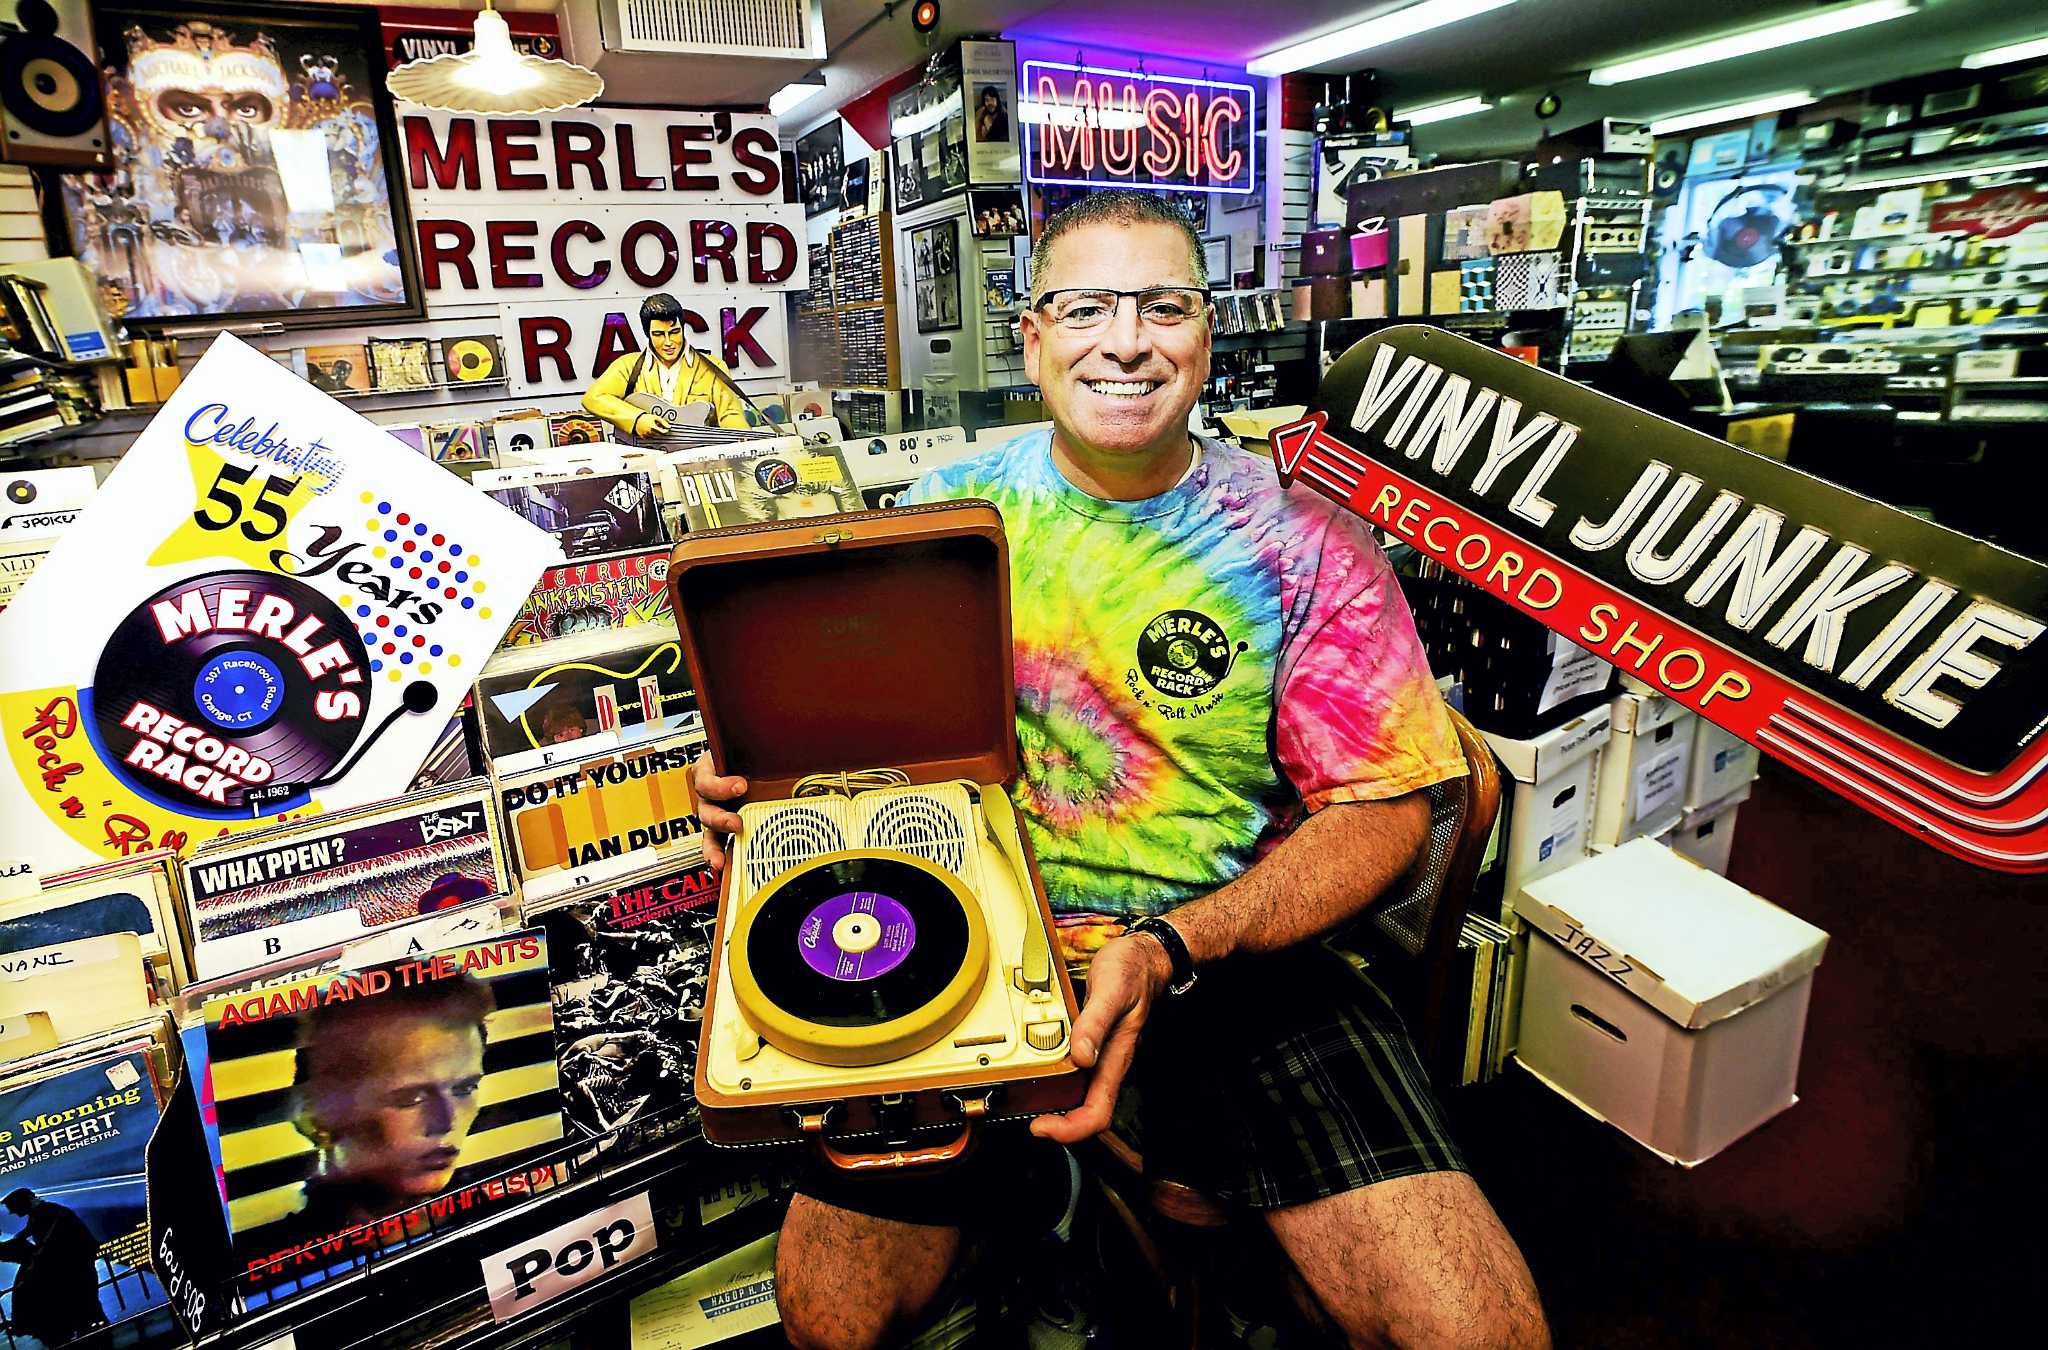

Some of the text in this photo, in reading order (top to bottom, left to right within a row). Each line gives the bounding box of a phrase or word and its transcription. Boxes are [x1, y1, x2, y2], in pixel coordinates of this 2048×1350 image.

[402, 112, 781, 196] MERLE'S
[1038, 75, 1243, 181] MUSIC
[417, 218, 799, 290] RECORD
[184, 403, 347, 496] Celebrating
[193, 463, 303, 542] 55
[681, 470, 738, 507] BILLY
[1350, 341, 2048, 730] VINYL JUNKIE
[269, 524, 443, 625] Years
[1370, 485, 1752, 708] RECORD SHOP
[150, 587, 365, 722] MERLE'S
[1146, 617, 1228, 659] MERLE'S
[204, 660, 277, 712] 307 Racebrook Road
[1151, 665, 1206, 687] RECORD
[1156, 677, 1195, 695] RACK
[202, 693, 253, 724] Orange, CT
[1157, 704, 1187, 721] Roll
[22, 696, 85, 793] Rock
[120, 700, 276, 785] RECORD
[124, 738, 241, 806] RACK
[266, 785, 290, 798] 1962
[500, 740, 711, 812] DO IT YOURSE
[567, 814, 704, 869] IAN DURY
[607, 884, 660, 919] THE
[1, 952, 75, 974] VANI
[263, 936, 282, 957] B
[405, 935, 425, 955] A
[1553, 923, 1633, 985] JAZZ
[217, 936, 541, 1031] ADAM AND THE ANTS
[20, 1087, 141, 1136] Morning
[0, 1128, 121, 1175] AND HIS ORCHESTRA
[506, 1165, 556, 1196] SOX
[506, 1217, 637, 1302] Pop
[711, 1290, 745, 1308] HAGOP
